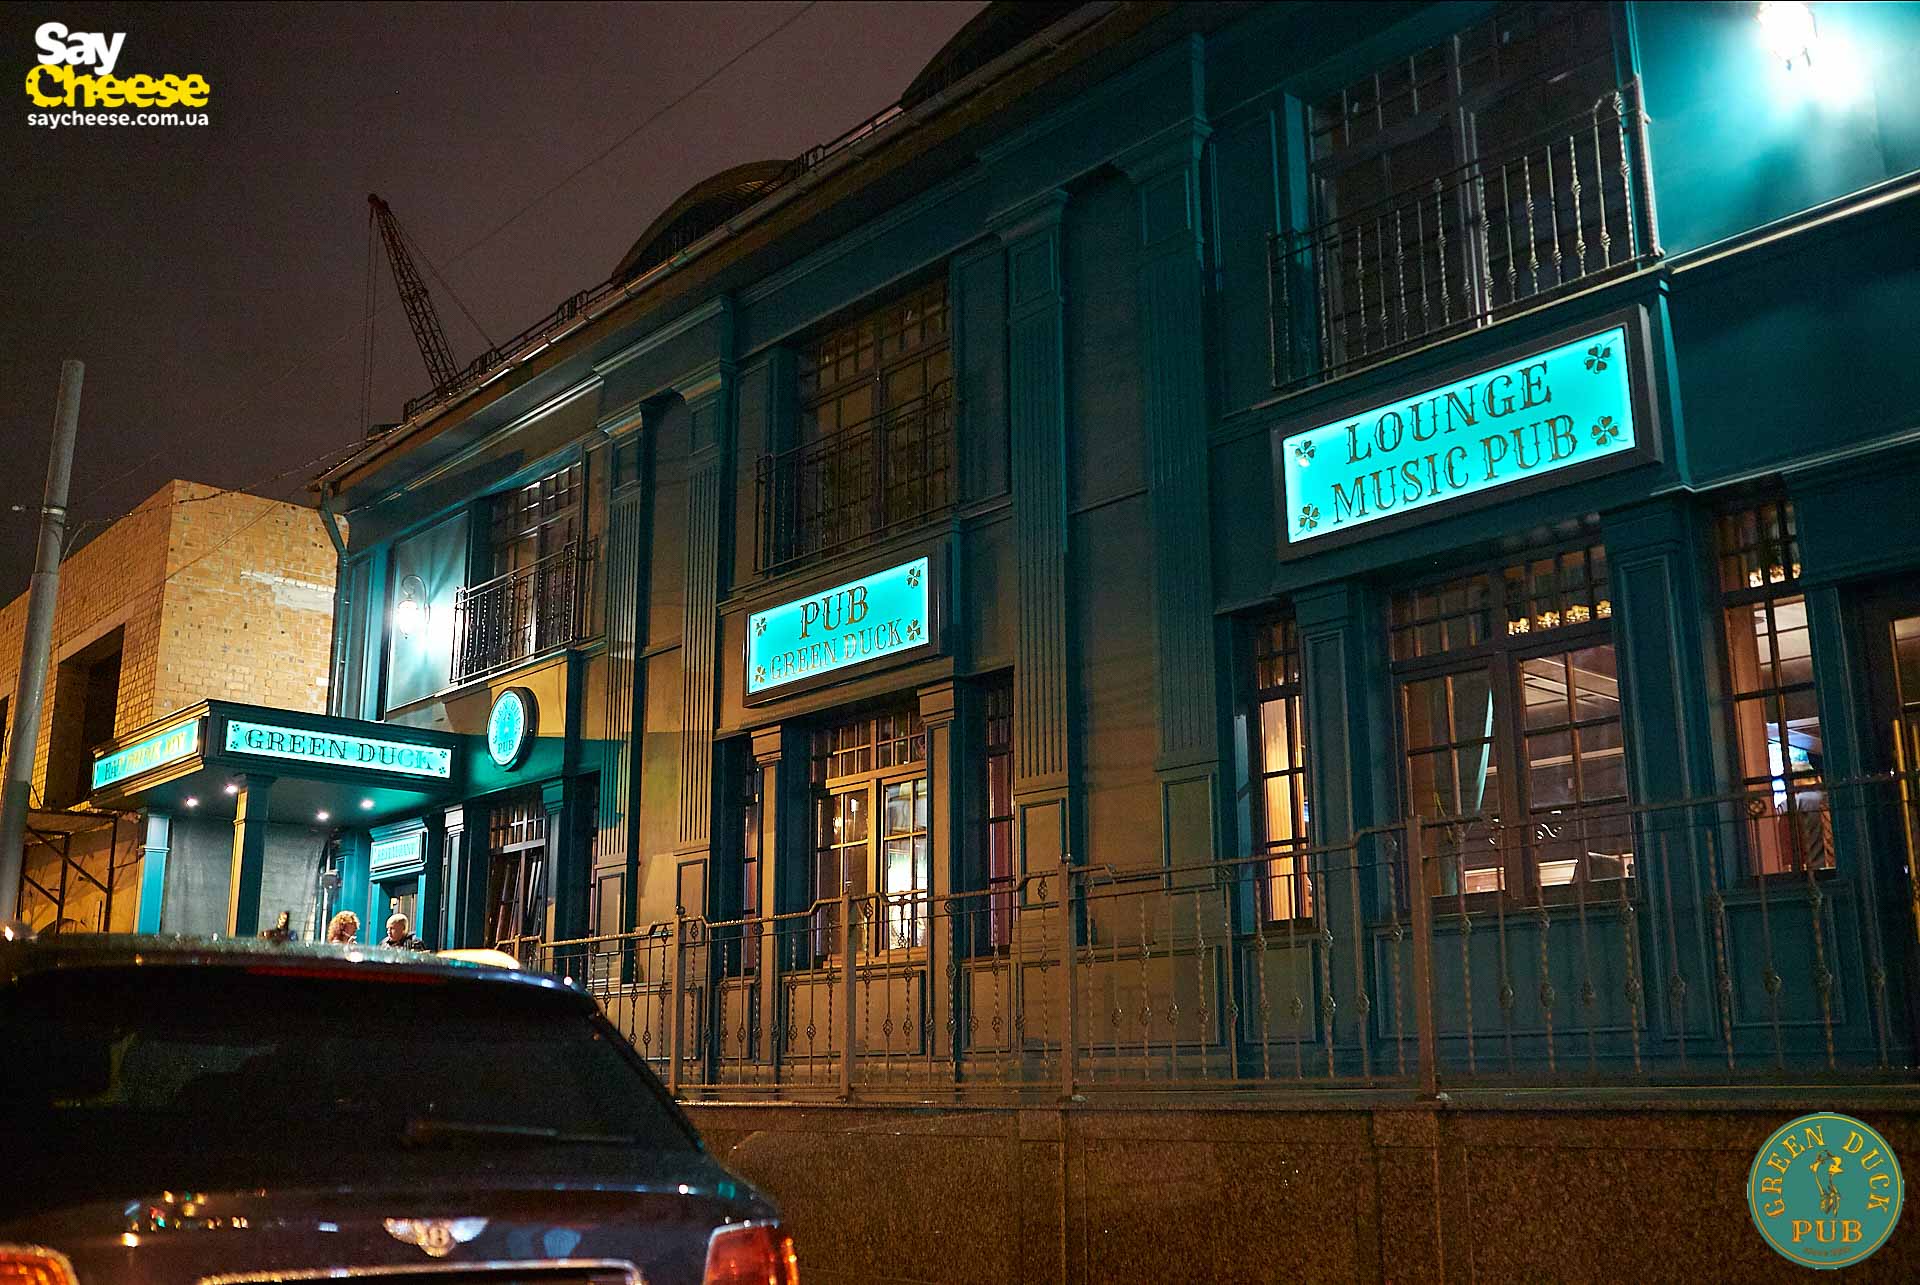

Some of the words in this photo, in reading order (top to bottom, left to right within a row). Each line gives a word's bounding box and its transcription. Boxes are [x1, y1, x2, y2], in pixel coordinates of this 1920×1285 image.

[1345, 360, 1551, 465] LOUNGE
[1331, 446, 1469, 525] MUSIC
[1480, 414, 1578, 481] PUB
[799, 585, 869, 640] PUB
[769, 638, 837, 680] GREEN
[843, 619, 903, 659] DUCK
[244, 729, 348, 759] GREEN
[356, 743, 434, 770] DUCK
[497, 738, 515, 754] PUB
